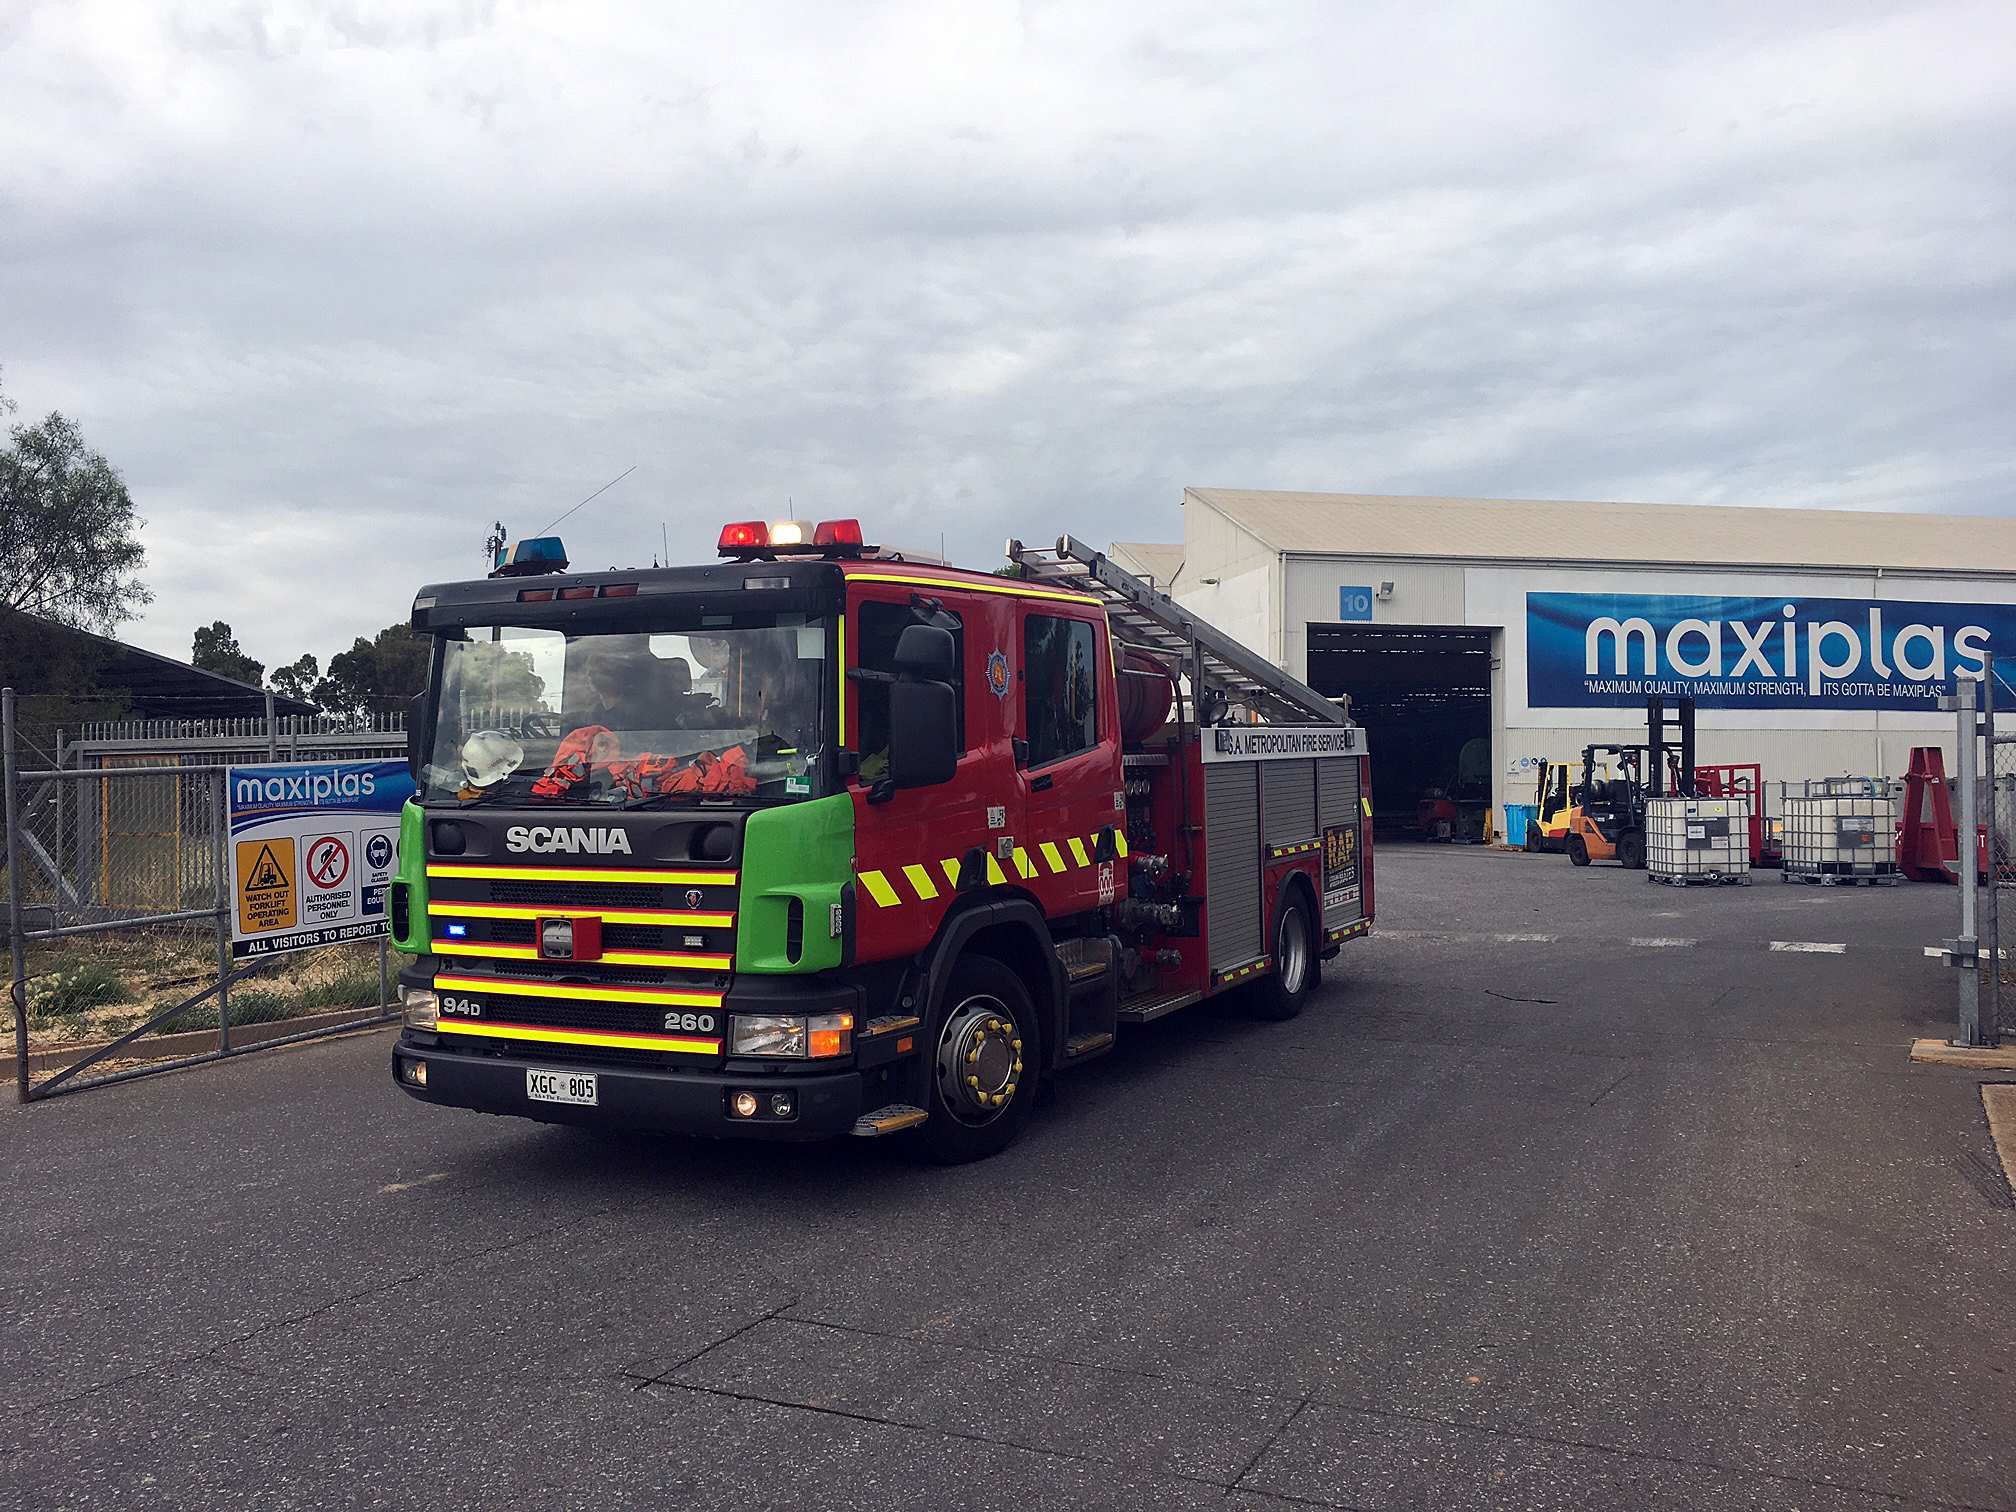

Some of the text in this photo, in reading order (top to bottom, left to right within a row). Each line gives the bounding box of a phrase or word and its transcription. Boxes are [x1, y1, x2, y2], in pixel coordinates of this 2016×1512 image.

[1344, 594, 1368, 612] 10
[1585, 604, 1991, 696] maxiplas
[1644, 681, 1691, 697] QUALITY,
[1694, 682, 1746, 695] MAXIMUM
[1749, 682, 1807, 697] STRENGTH,
[1823, 683, 1839, 696] ITS
[1841, 683, 1875, 697] GOTTA
[1877, 684, 1892, 697] BE
[1244, 734, 1301, 754] METROPOLITAN
[1302, 734, 1318, 752] FIRE
[1318, 734, 1345, 751] SERVICE
[237, 769, 375, 805] maxiplas
[506, 826, 632, 854] SCANIA
[246, 890, 289, 902] WATCH OUT
[306, 891, 352, 903] AUTHORISED
[247, 908, 289, 920] OPERATING
[249, 900, 286, 911] FORKLIFT
[307, 900, 350, 912] PERSONNEL
[320, 910, 338, 919] ONLY
[259, 918, 279, 927] AREA
[248, 942, 269, 953] ALL
[272, 932, 320, 949] VISITORS
[323, 931, 337, 941] TO
[339, 924, 378, 939] REPORT
[443, 997, 481, 1016] 94D
[664, 1012, 715, 1032] 260
[530, 1074, 594, 1098] XGC 805
